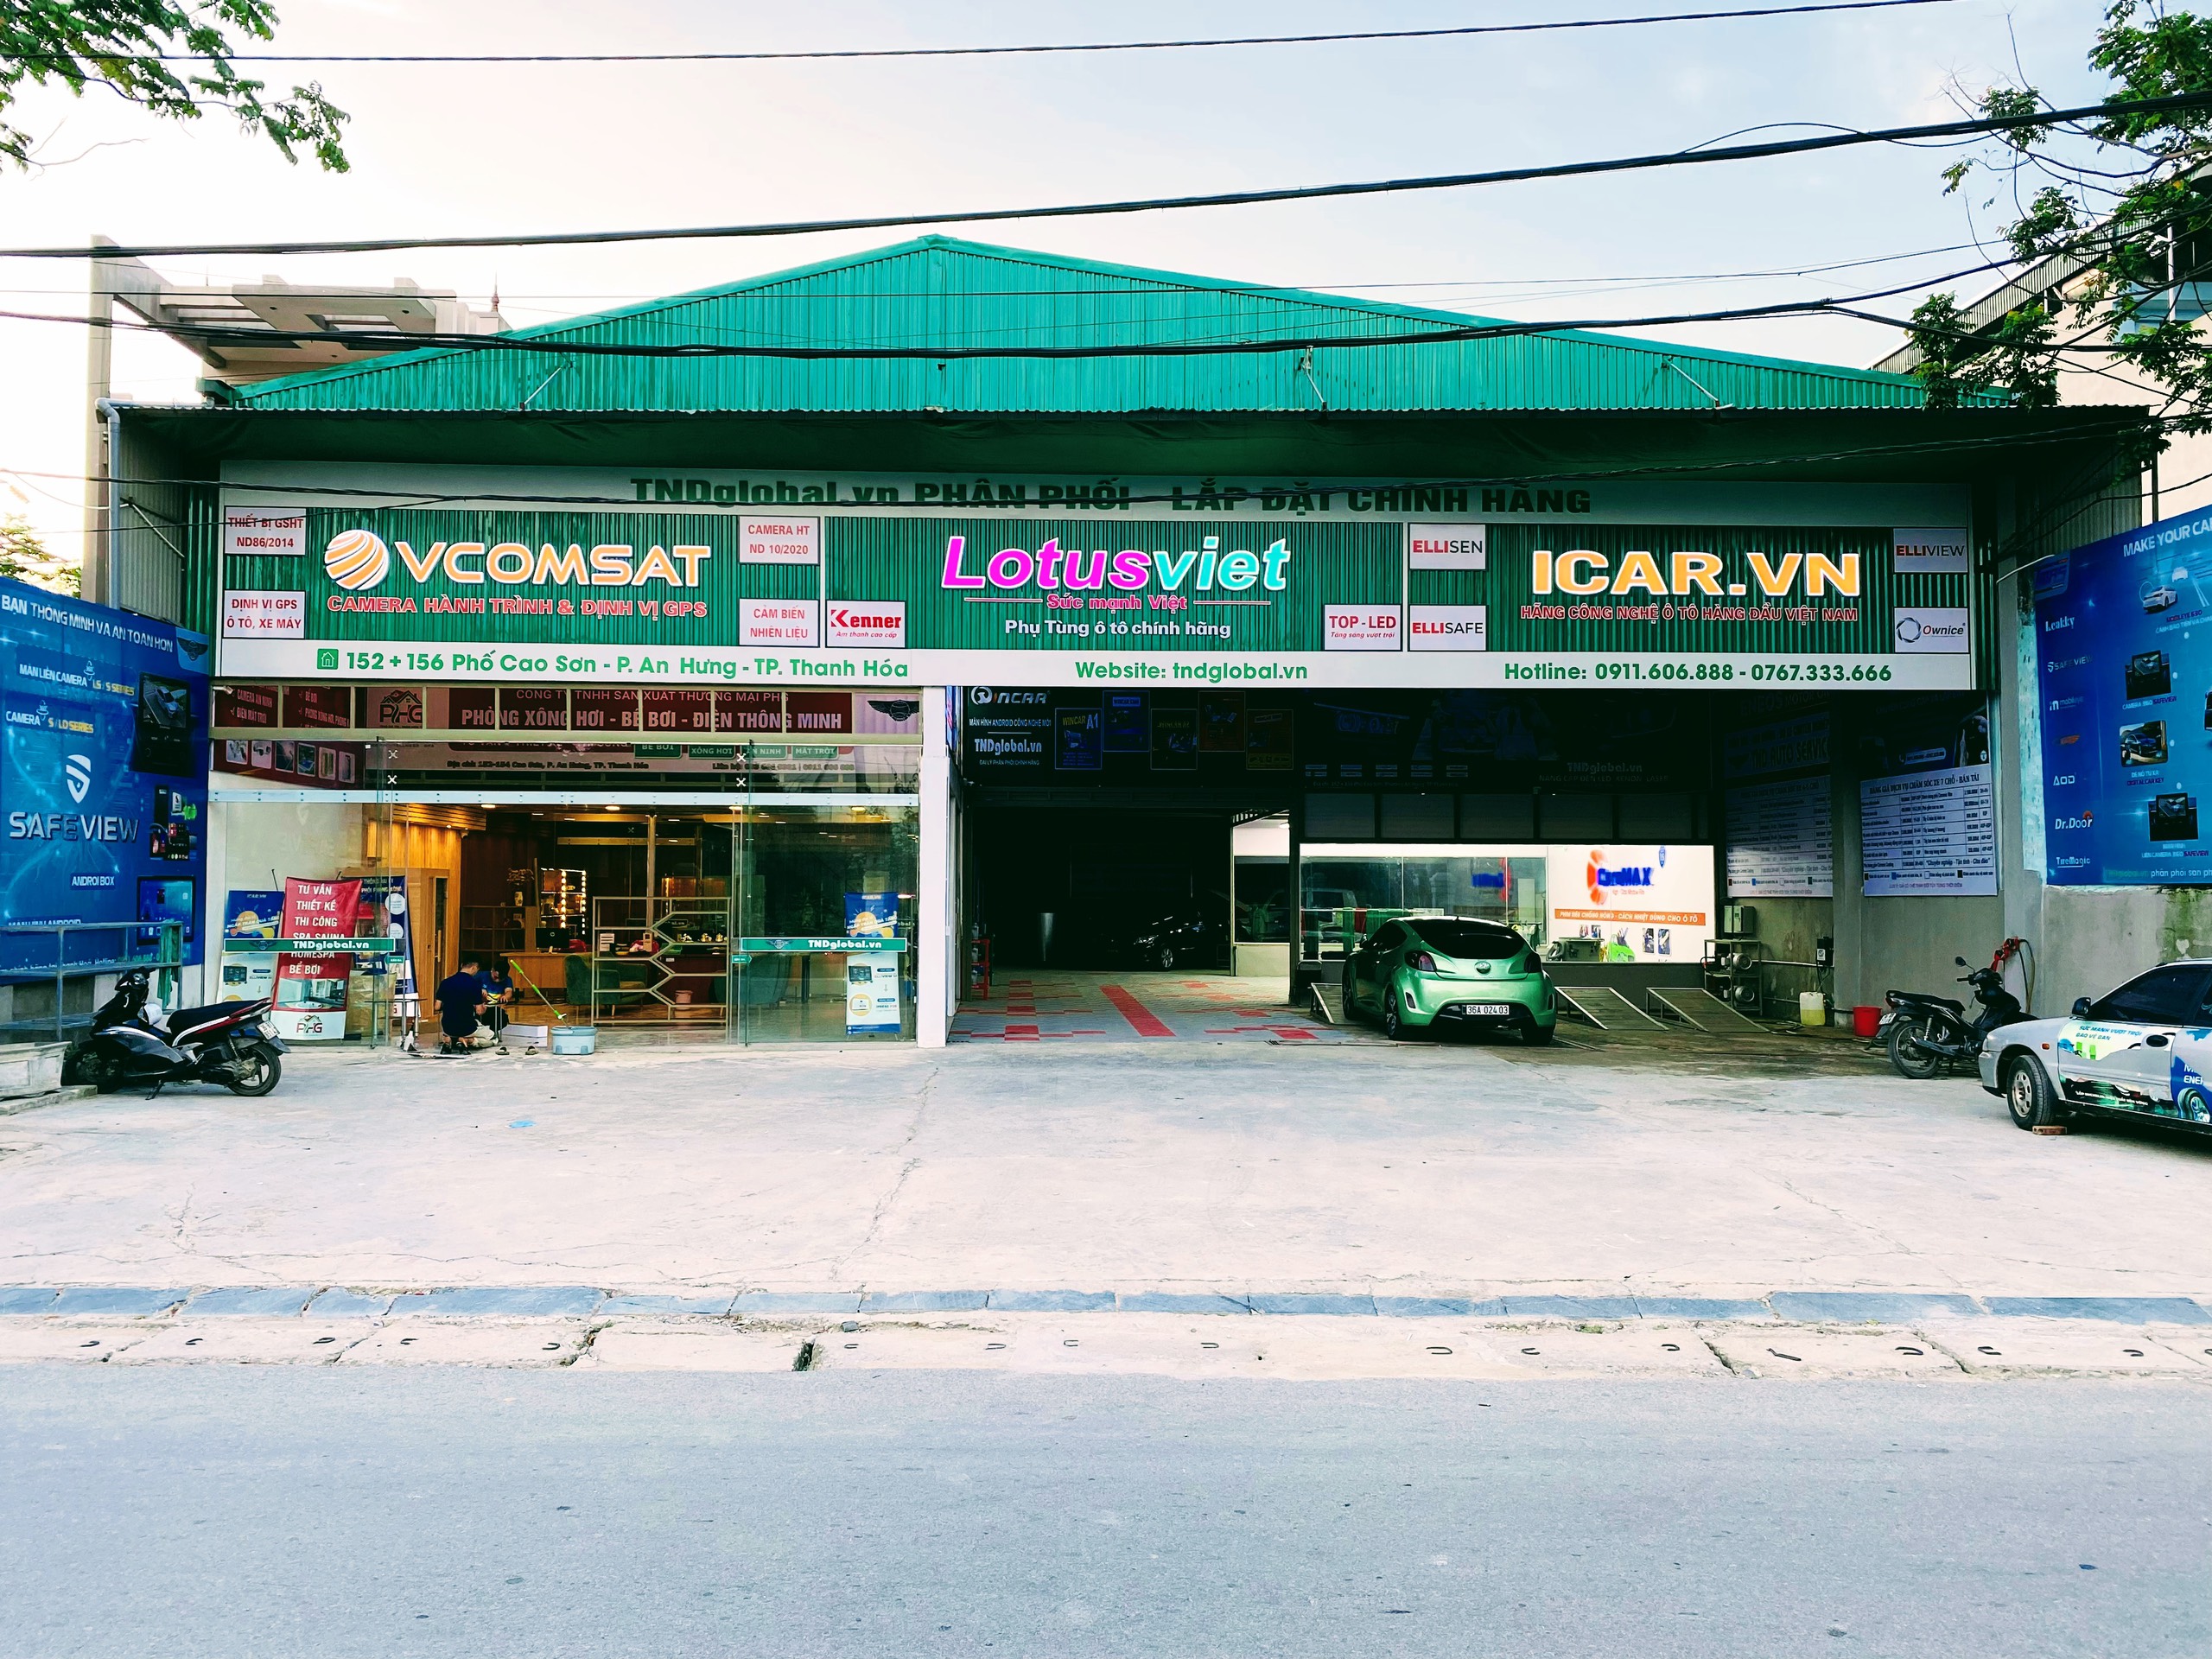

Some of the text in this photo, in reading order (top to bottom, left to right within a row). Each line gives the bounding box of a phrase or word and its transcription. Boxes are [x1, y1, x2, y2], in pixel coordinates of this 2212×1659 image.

[631, 479, 899, 508] TNDglobal.vn
[915, 478, 1026, 510] PHÂN
[261, 518, 272, 531] BỊ
[275, 518, 304, 529] GSHT
[748, 524, 810, 535] CAMERA HT
[236, 537, 295, 548] ND86/2014
[1413, 540, 1483, 554] ELLISEN
[2123, 524, 2190, 557] MAKE YOUR
[749, 544, 809, 555] ND 10/2020
[1896, 545, 1965, 556] ELLIVIEW
[393, 541, 712, 589] VCOMSAT
[941, 535, 1291, 591] Lotusviet
[1531, 549, 1861, 596] ICAR.VN
[232, 599, 297, 612] ĐỊNH VỊ GPS
[326, 592, 709, 622] CAMERA HÀNH TRÌNH & ĐỊNH VỊ GPS
[1046, 593, 1188, 613] Sức mạnh Việt
[781, 605, 805, 620] BIẾN
[830, 609, 901, 629] Kenner
[1520, 601, 1859, 626] HÃNG CÔNG NGHỆ Ô TÔ HÀNG ĐẦU VIỆT NAM
[69, 613, 95, 632] MINH
[112, 627, 126, 640] AN
[226, 615, 302, 629] Ô TÔ, XE MÁY
[1005, 620, 1231, 639] Phụ Tùng ô tô chính hãng
[1329, 615, 1396, 629] TOP LED
[1412, 622, 1484, 634] ELLISAFE
[750, 626, 808, 641] NHIÊN LIỆU
[1923, 625, 1964, 635] Ownice
[346, 652, 384, 670] 152
[407, 652, 444, 670] 156
[452, 650, 497, 671] Phố
[500, 654, 548, 672] Cao
[555, 655, 596, 672] Sơn
[617, 656, 632, 673] P.
[639, 657, 669, 673] An
[680, 658, 736, 679] Hưng
[754, 658, 782, 675] TP.
[790, 659, 855, 677] Thanh
[863, 658, 908, 677] Hóa
[1075, 660, 1307, 683] Website: tndglobal.vn
[56, 671, 87, 687] CAMERA
[1504, 663, 1892, 682] Hotline: 0911.606.888 0767.333.666
[575, 690, 610, 700] TNHH
[5, 710, 41, 726] CAMERA
[461, 705, 518, 726] PHÒNG
[524, 707, 567, 727] XÔNG
[575, 709, 604, 727] HƠI
[648, 709, 677, 728] BƠI
[738, 709, 792, 728] THÔNG
[798, 713, 842, 729] MINH
[1086, 713, 1099, 729] A1
[974, 738, 1042, 755] TNDglobal.vn
[2055, 817, 2093, 830] Dr.Door
[72, 875, 115, 887] ANDROI BOX
[298, 883, 332, 895] TƯ VẤN
[296, 899, 336, 911] THIẾT KẾ
[295, 915, 337, 926] THI CÔNG
[293, 940, 369, 950] TNDglobal.vn
[808, 939, 882, 950] TNDglobal.vn
[289, 960, 320, 975] BỂ BƠI
[296, 1022, 322, 1033] PHG
